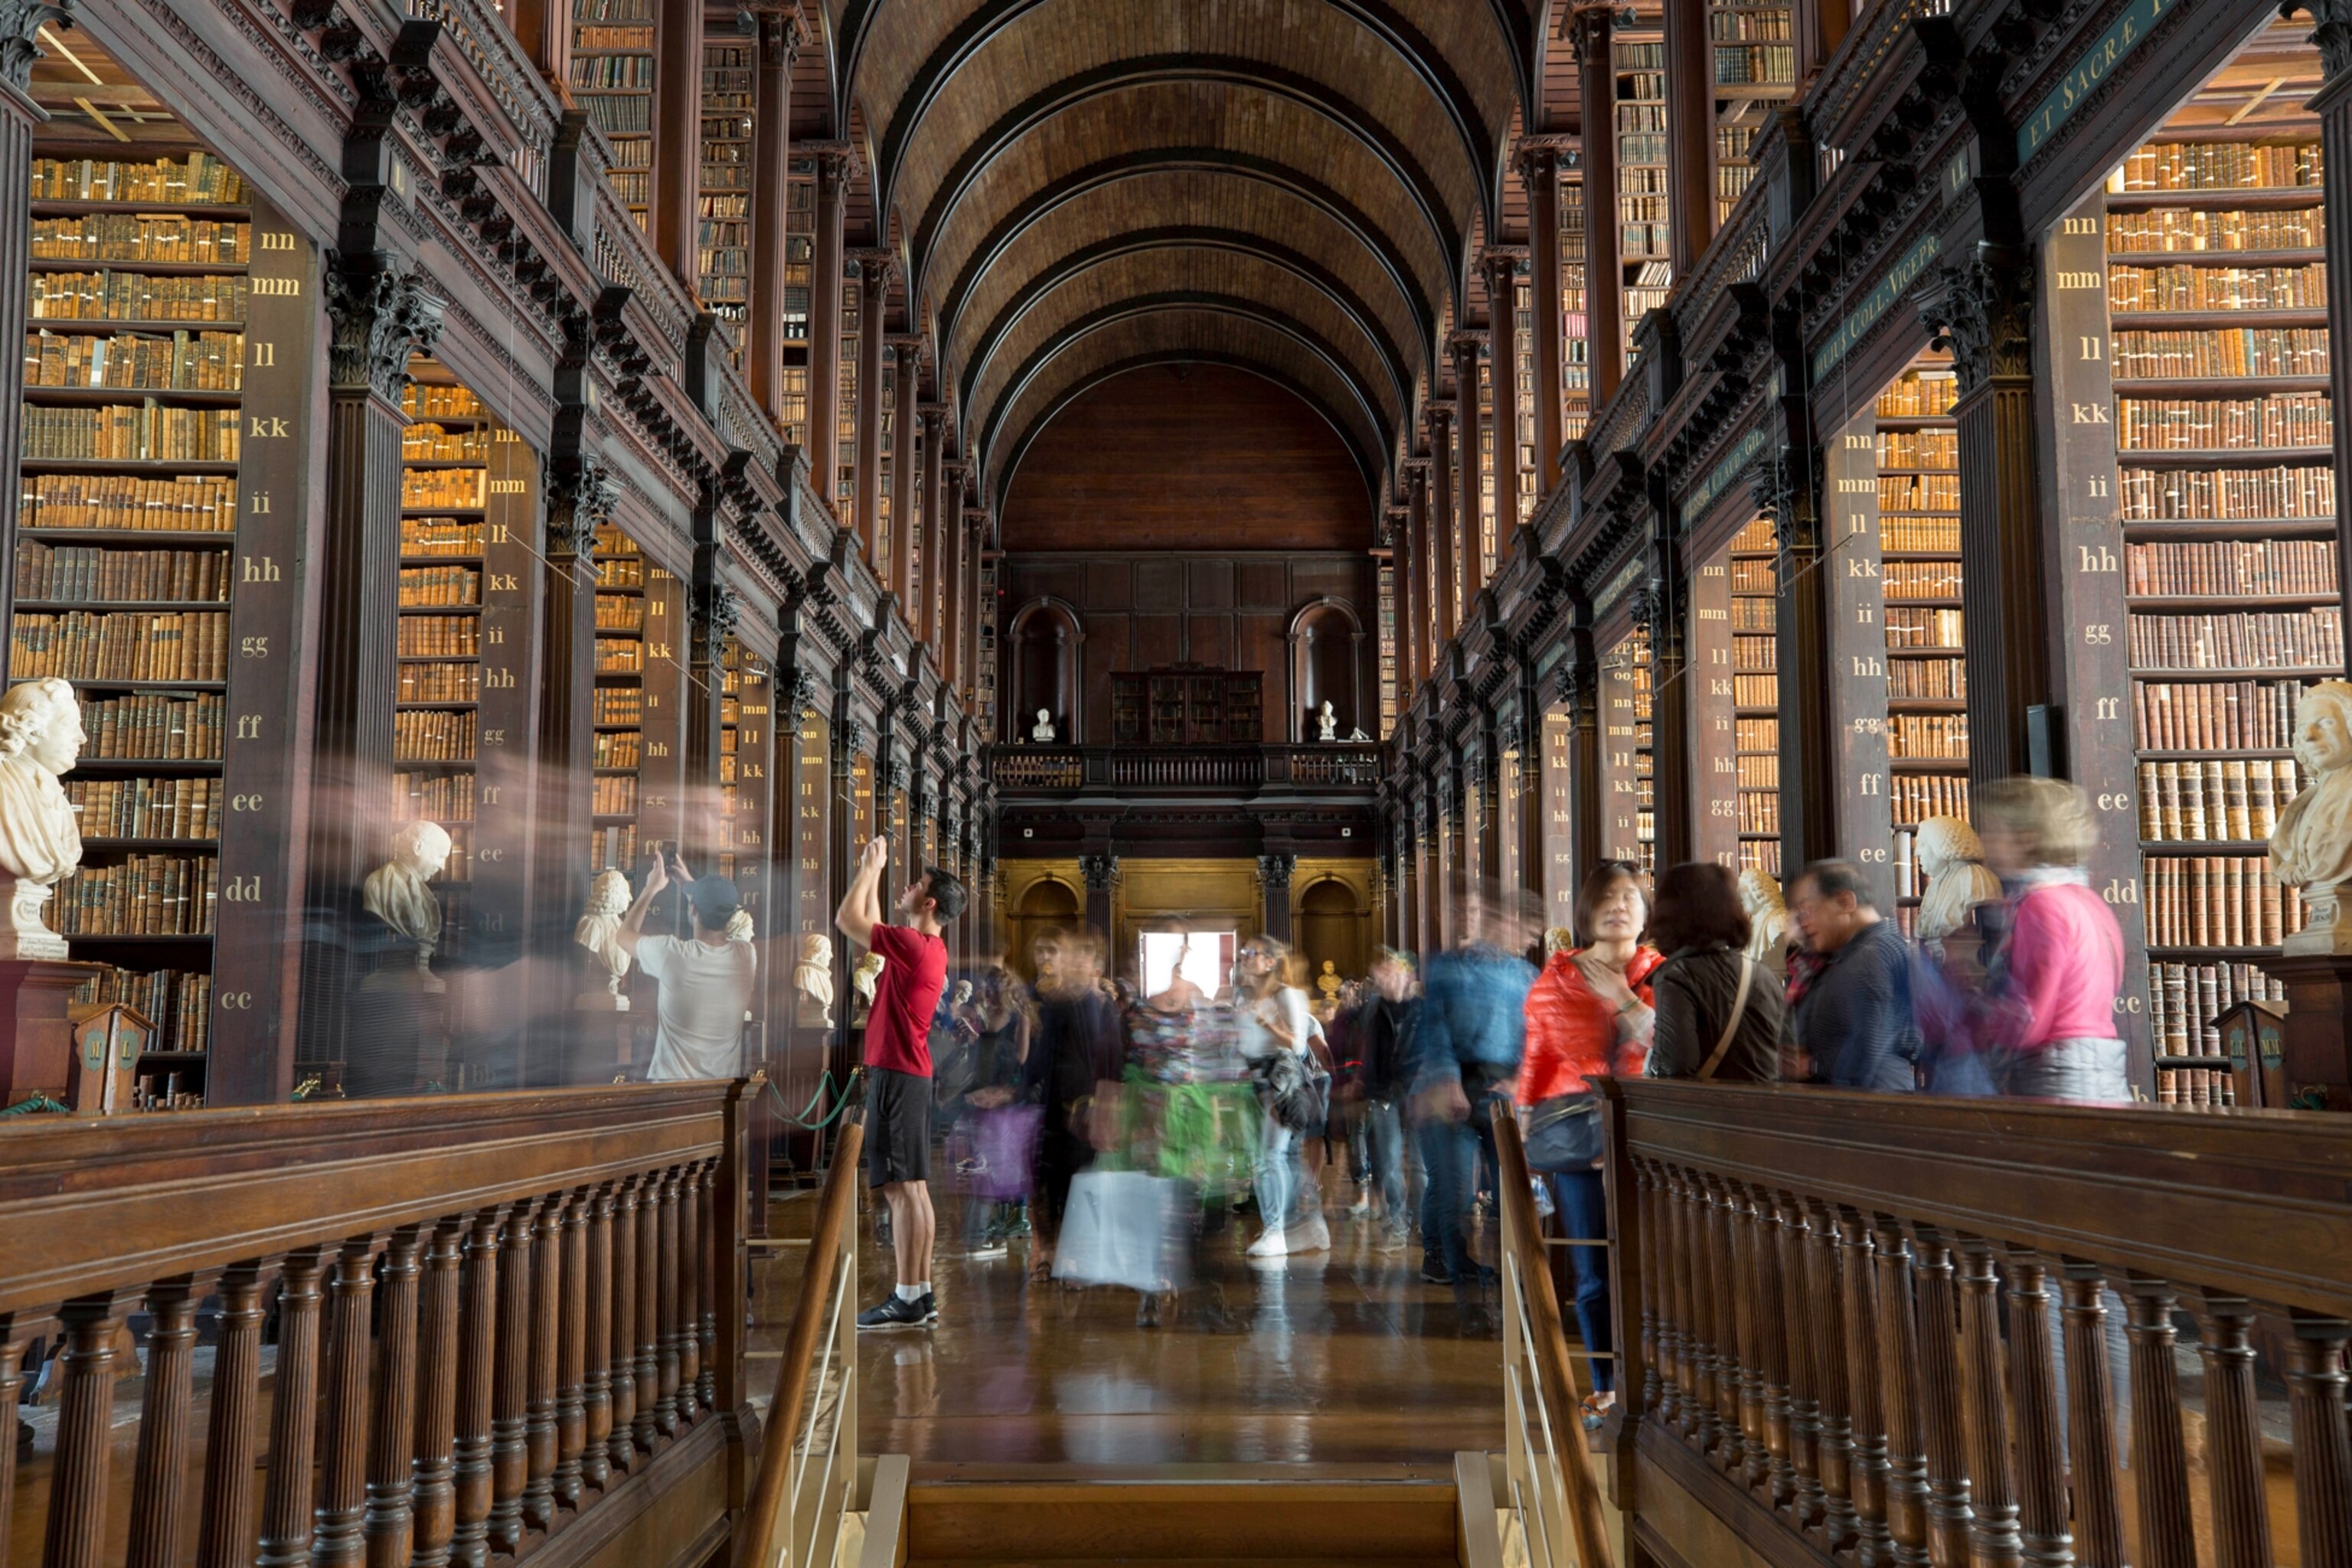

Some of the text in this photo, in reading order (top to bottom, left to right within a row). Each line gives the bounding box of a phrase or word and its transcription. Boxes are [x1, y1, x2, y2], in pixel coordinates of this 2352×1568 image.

[2030, 15, 2138, 148] ET SACRÆ
[2063, 218, 2097, 234] nn
[260, 234, 296, 250] nn
[252, 278, 299, 296] mm
[2056, 272, 2101, 289] mm
[254, 343, 274, 366] ll
[2080, 337, 2101, 360] ll
[2072, 403, 2109, 423] kk
[250, 417, 289, 437] kk
[1845, 436, 1872, 449] nn
[490, 479, 525, 493] mm
[1838, 479, 1875, 492] mm
[2089, 475, 2108, 497] ii
[252, 491, 270, 513] ii
[1851, 514, 1867, 533] ll
[492, 524, 508, 543] ll
[2079, 546, 2118, 572] hh
[242, 557, 280, 582] hh
[1704, 567, 1724, 576] nn
[1849, 559, 1879, 577] kk
[490, 574, 518, 590] kk
[652, 602, 664, 615] ll
[1700, 609, 1727, 620] mm
[1858, 603, 1873, 622] ii
[489, 626, 503, 643] ii
[2085, 625, 2111, 645] gg
[241, 636, 269, 658] gg
[649, 643, 671, 658] kk
[1712, 648, 1727, 664] ll
[1853, 657, 1881, 676] hh
[485, 668, 514, 688] hh
[744, 675, 760, 684] nn
[1614, 672, 1631, 681] oo
[1711, 679, 1732, 695] kk
[648, 695, 658, 707] ii
[1614, 699, 1632, 707] nn
[2096, 697, 2118, 720] ff
[743, 705, 767, 714] mm
[237, 715, 262, 738] ff
[1609, 726, 1632, 736] mm
[1716, 716, 1728, 730] ii
[1854, 718, 1880, 733] gg
[484, 729, 505, 746] gg
[745, 730, 757, 743] ll
[802, 731, 817, 740] nn
[1555, 734, 1565, 746] ll
[648, 742, 668, 756] hh
[1552, 756, 1567, 768] kk
[1615, 753, 1628, 766] ll
[1714, 757, 1733, 773] hh
[743, 764, 763, 777] kk
[802, 783, 812, 795] ll
[1556, 787, 1566, 797] ii
[1615, 780, 1633, 792] kk
[1861, 773, 1881, 795] ff
[232, 795, 263, 811] ee
[483, 786, 501, 804] ff
[645, 795, 666, 808] gg
[2098, 793, 2128, 811] ee
[743, 799, 754, 810] ii
[801, 806, 818, 818] kk
[1711, 800, 1734, 817] gg
[1554, 810, 1569, 822] hh
[1619, 815, 1628, 828] ii
[743, 831, 760, 843] hh
[480, 848, 502, 861] ee
[1555, 854, 1570, 864] gg
[1616, 847, 1635, 860] hh
[1717, 851, 1733, 867] ff
[1860, 848, 1886, 862] ee
[741, 866, 757, 877] gg
[802, 858, 818, 869] hh
[226, 876, 260, 901] dd
[1558, 890, 1570, 902] ff
[2103, 879, 2138, 903] dd
[221, 992, 251, 1009] cc
[2112, 996, 2141, 1014] cc
[122, 1040, 131, 1057] L
